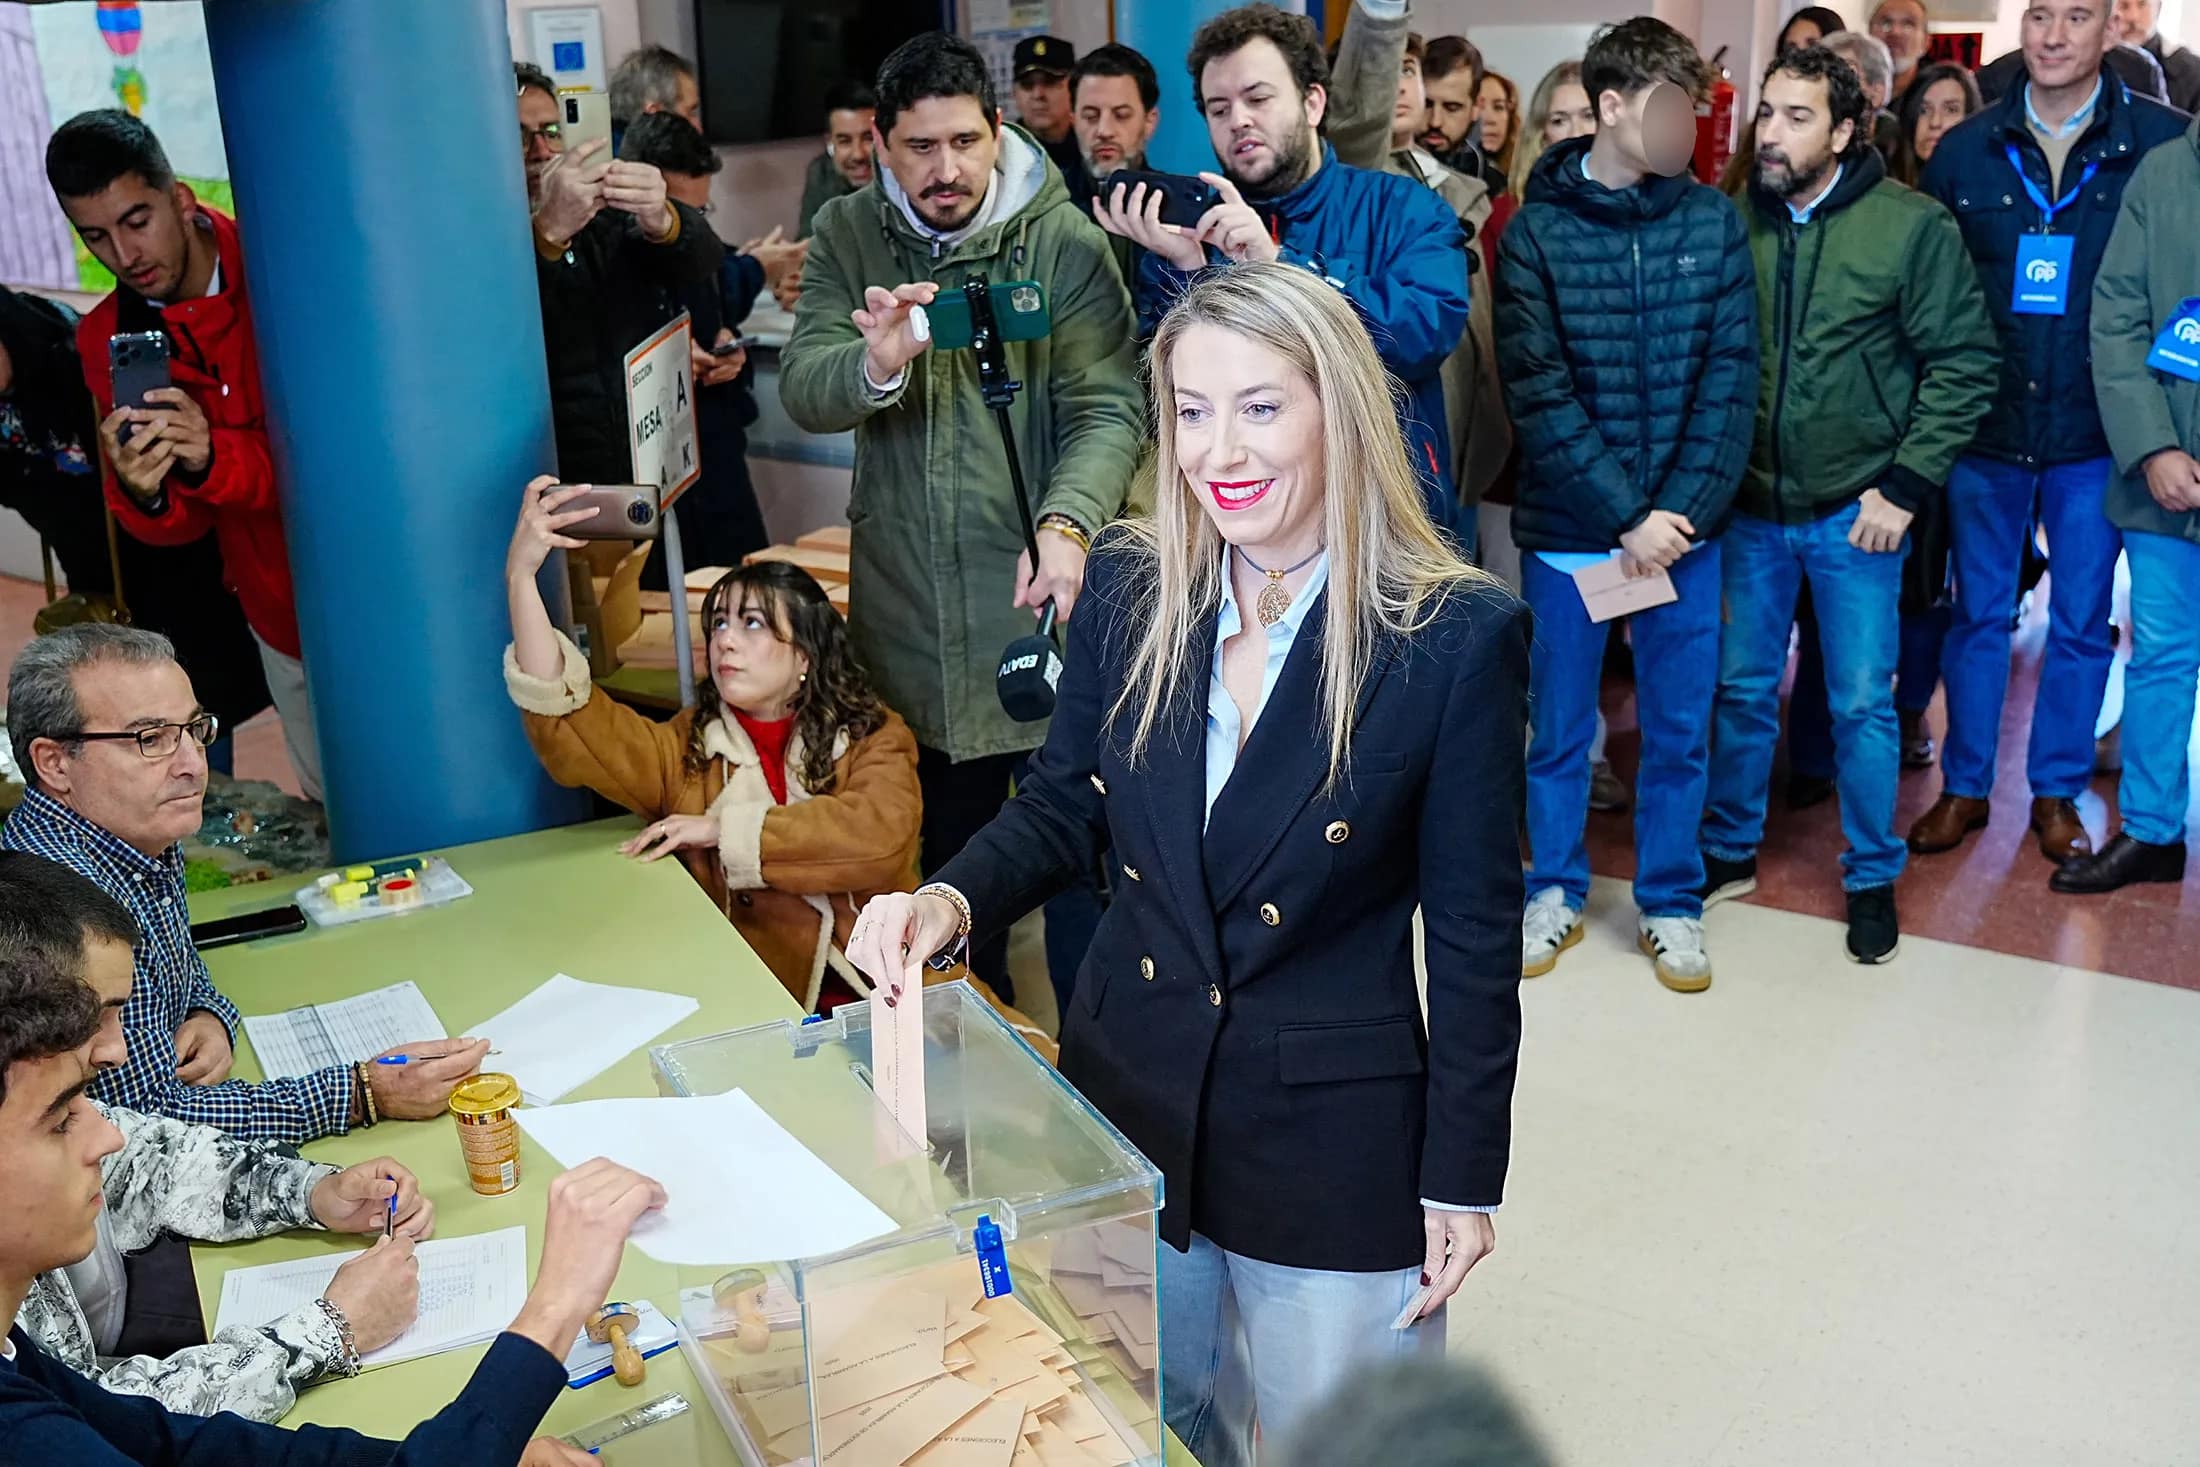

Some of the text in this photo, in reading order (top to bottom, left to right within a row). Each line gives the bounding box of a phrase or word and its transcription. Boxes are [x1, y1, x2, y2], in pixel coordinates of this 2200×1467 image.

[636, 370, 688, 448] MESA A
[661, 465, 668, 489] A
[682, 442, 691, 469] K
